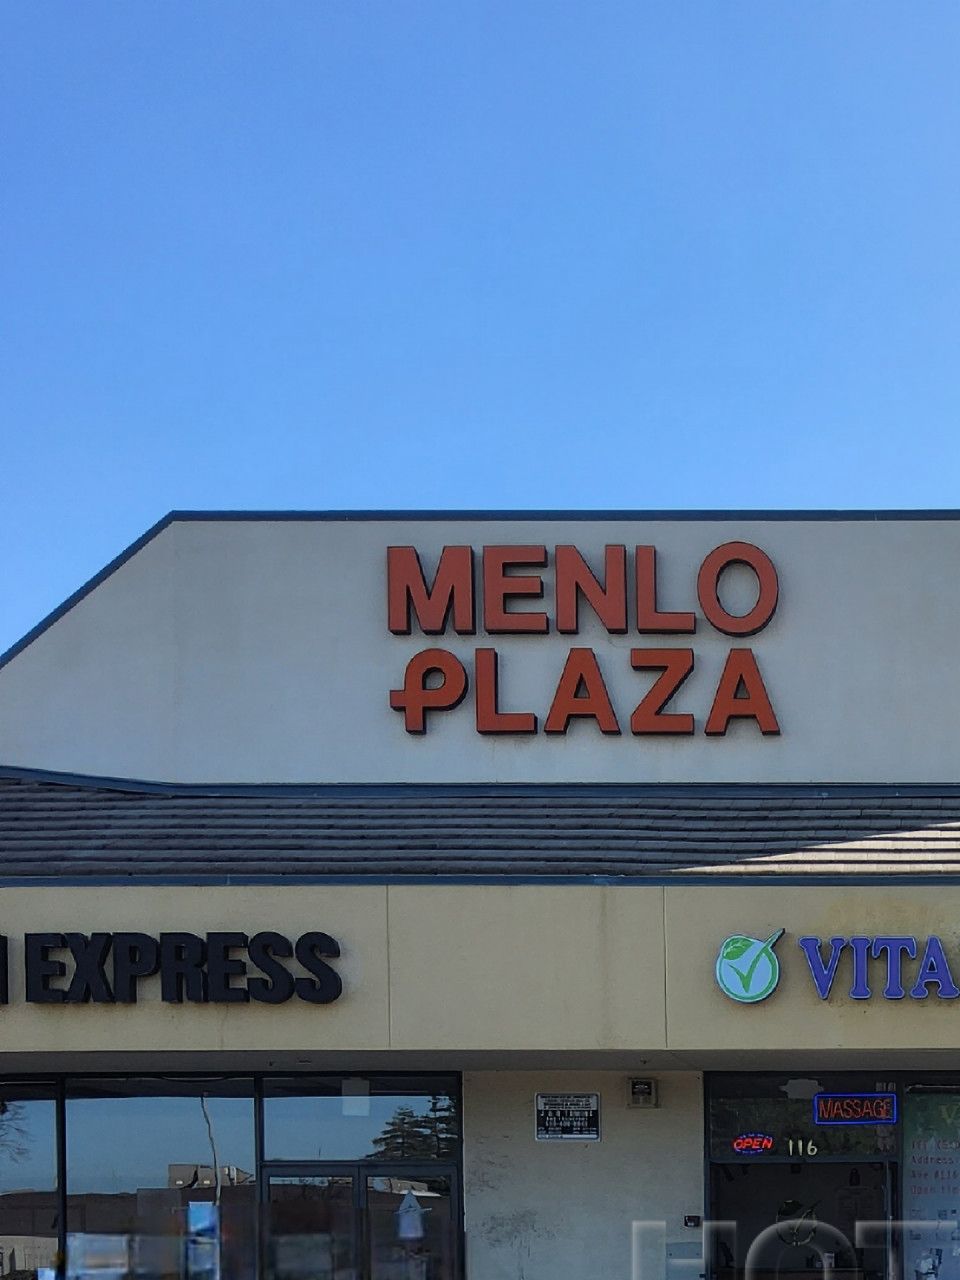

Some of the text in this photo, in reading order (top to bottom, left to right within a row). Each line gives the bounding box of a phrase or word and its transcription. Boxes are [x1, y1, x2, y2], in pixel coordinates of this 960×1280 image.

[387, 541, 779, 637] MENLO
[389, 648, 781, 736] PLAZA
[25, 931, 343, 1004] EXPRESS
[819, 1099, 893, 1119] MASSAGE
[733, 1137, 773, 1150] OPEN
[788, 1138, 818, 1156] 116
